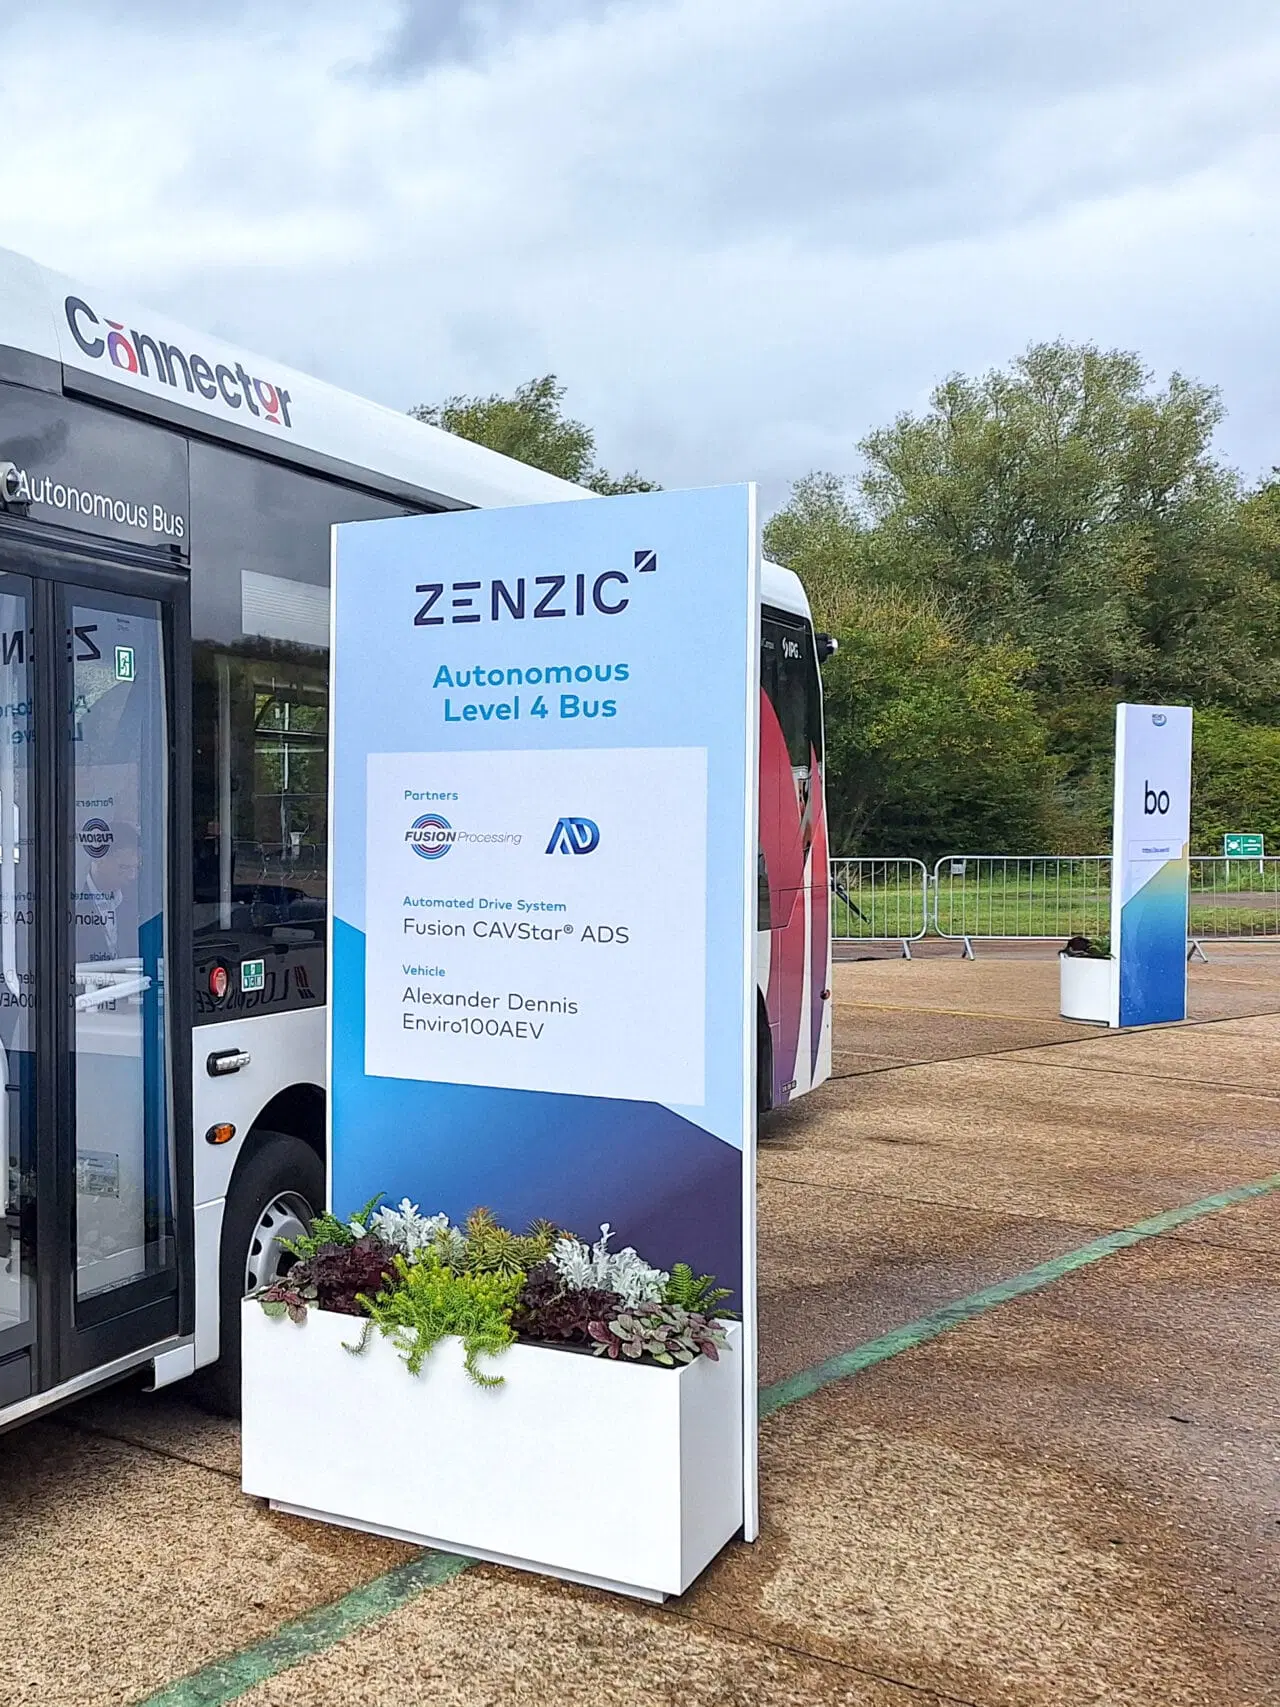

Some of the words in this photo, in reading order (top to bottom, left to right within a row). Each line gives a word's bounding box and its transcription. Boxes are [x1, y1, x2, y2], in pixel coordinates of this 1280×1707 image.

[16, 469, 148, 529] Autonomous
[152, 505, 185, 538] Bus
[413, 570, 630, 626] ZENZIC
[432, 663, 630, 689] Autonomous
[444, 695, 520, 722] Level
[530, 695, 549, 719] 4
[560, 694, 618, 719] Bus
[404, 790, 459, 801] Partners
[1144, 779, 1170, 815] bo
[404, 831, 457, 842] FUSION
[458, 831, 522, 846] Processing
[403, 896, 474, 909] Automated
[479, 898, 513, 910] Drive
[517, 899, 567, 913] System
[403, 918, 465, 937] Fusion
[473, 920, 574, 941] CAVStar®
[581, 925, 630, 944] ADS
[402, 964, 446, 977] Vehicle
[402, 987, 500, 1009] Alexander
[508, 993, 578, 1014] Dennis
[402, 1013, 545, 1039] Enviro100AEV
